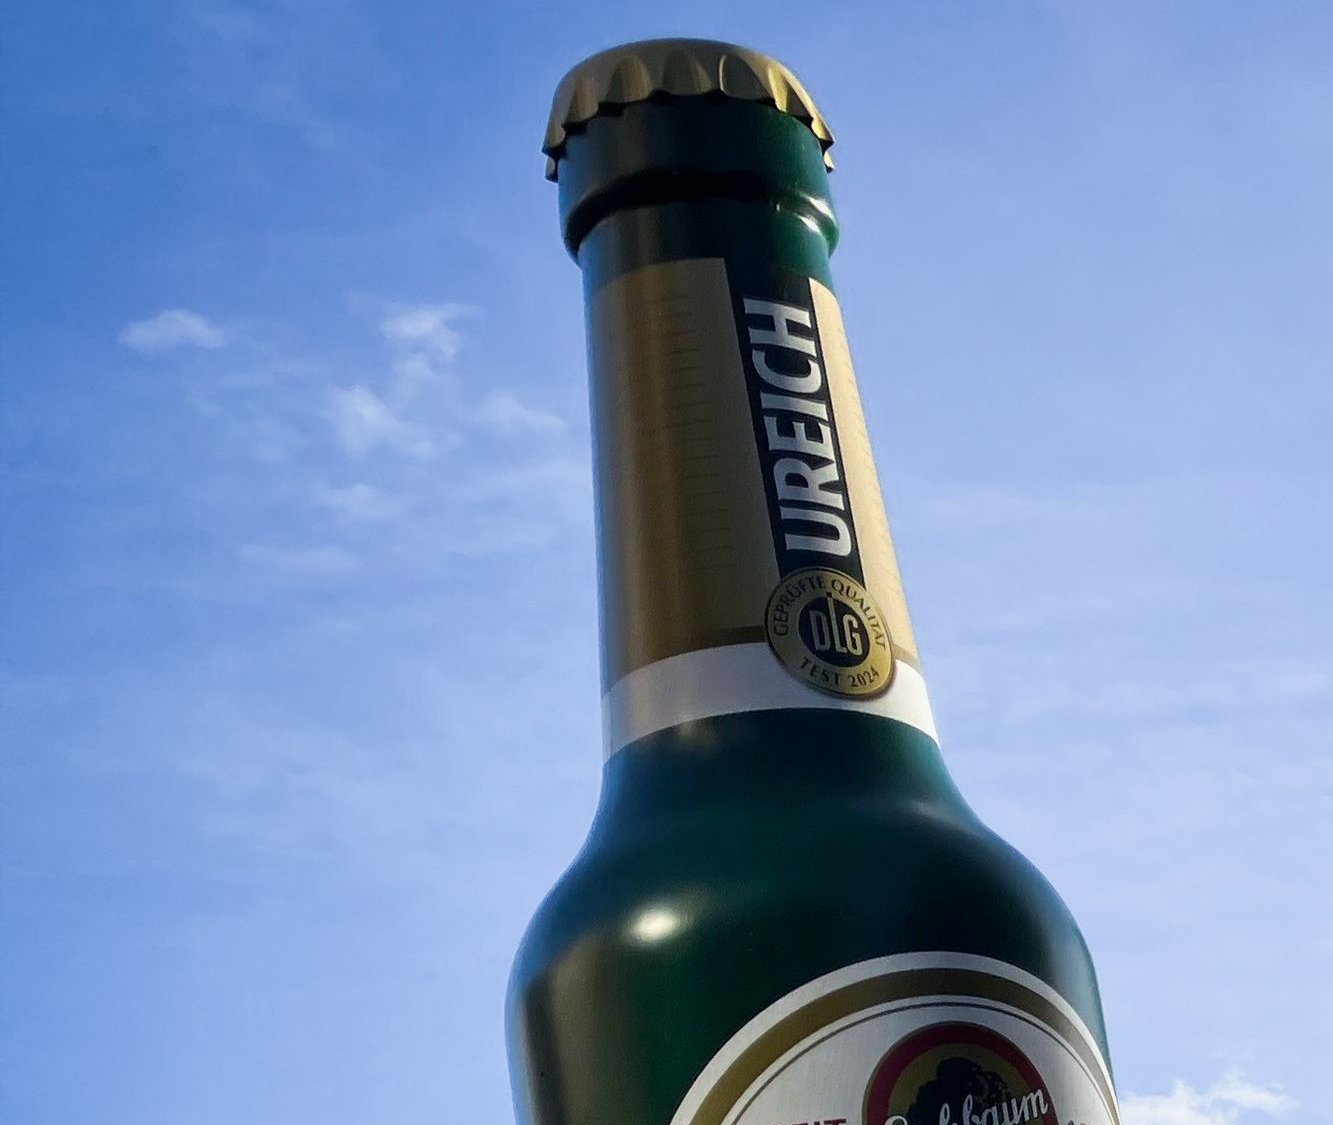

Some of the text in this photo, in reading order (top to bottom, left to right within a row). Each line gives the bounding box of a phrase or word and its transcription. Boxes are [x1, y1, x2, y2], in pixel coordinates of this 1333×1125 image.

[743, 296, 851, 557] UREICH
[773, 576, 827, 637] GEPRÜFTE
[808, 591, 863, 656] DLG
[800, 656, 880, 688] TEST 2024
